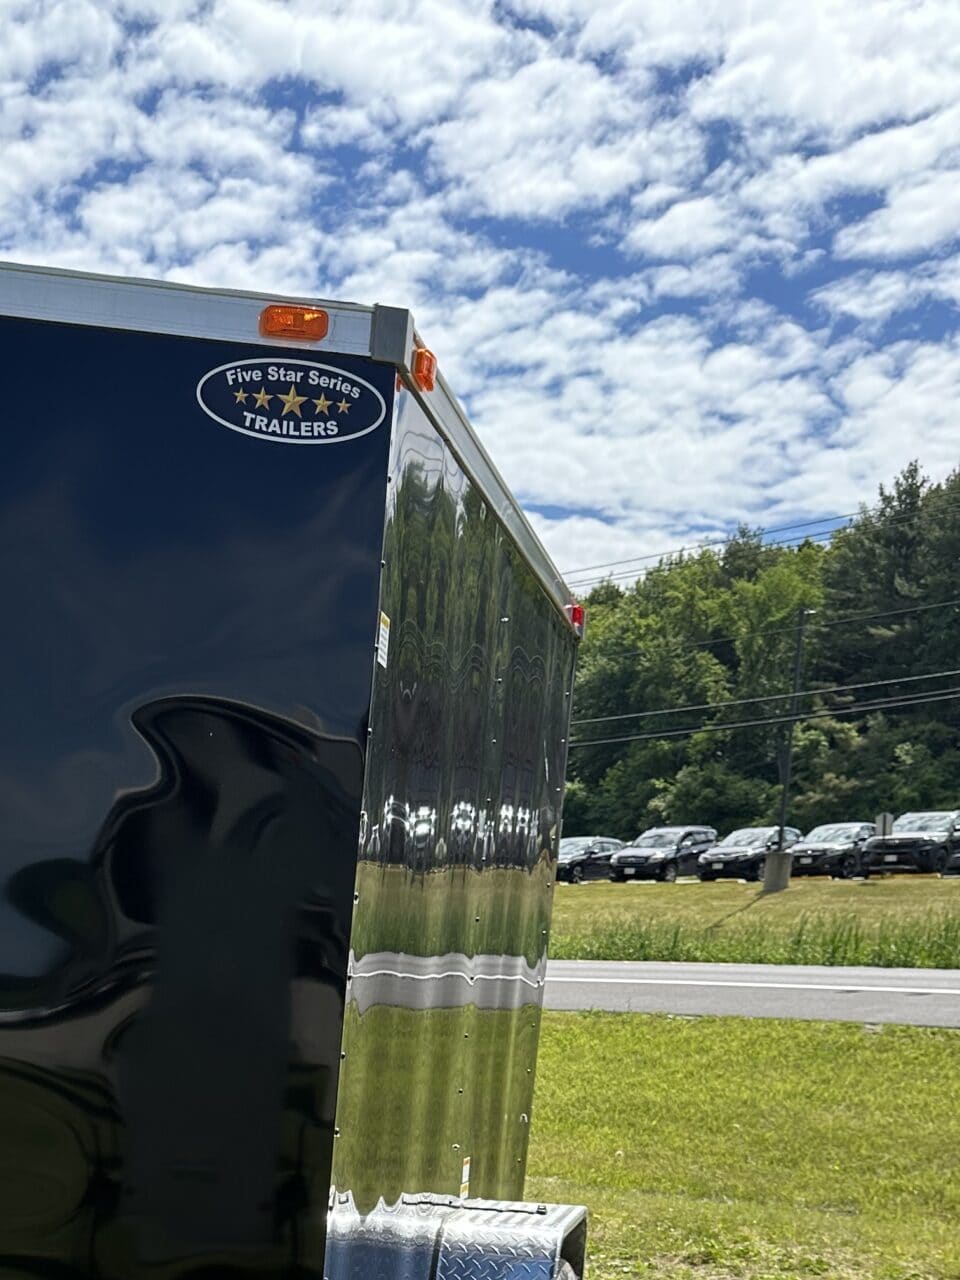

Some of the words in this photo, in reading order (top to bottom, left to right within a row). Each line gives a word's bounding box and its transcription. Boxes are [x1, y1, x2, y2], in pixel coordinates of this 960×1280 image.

[226, 369, 262, 386] Five
[267, 366, 304, 383] Star
[308, 370, 361, 399] Series
[243, 411, 339, 436] TRAILERS
